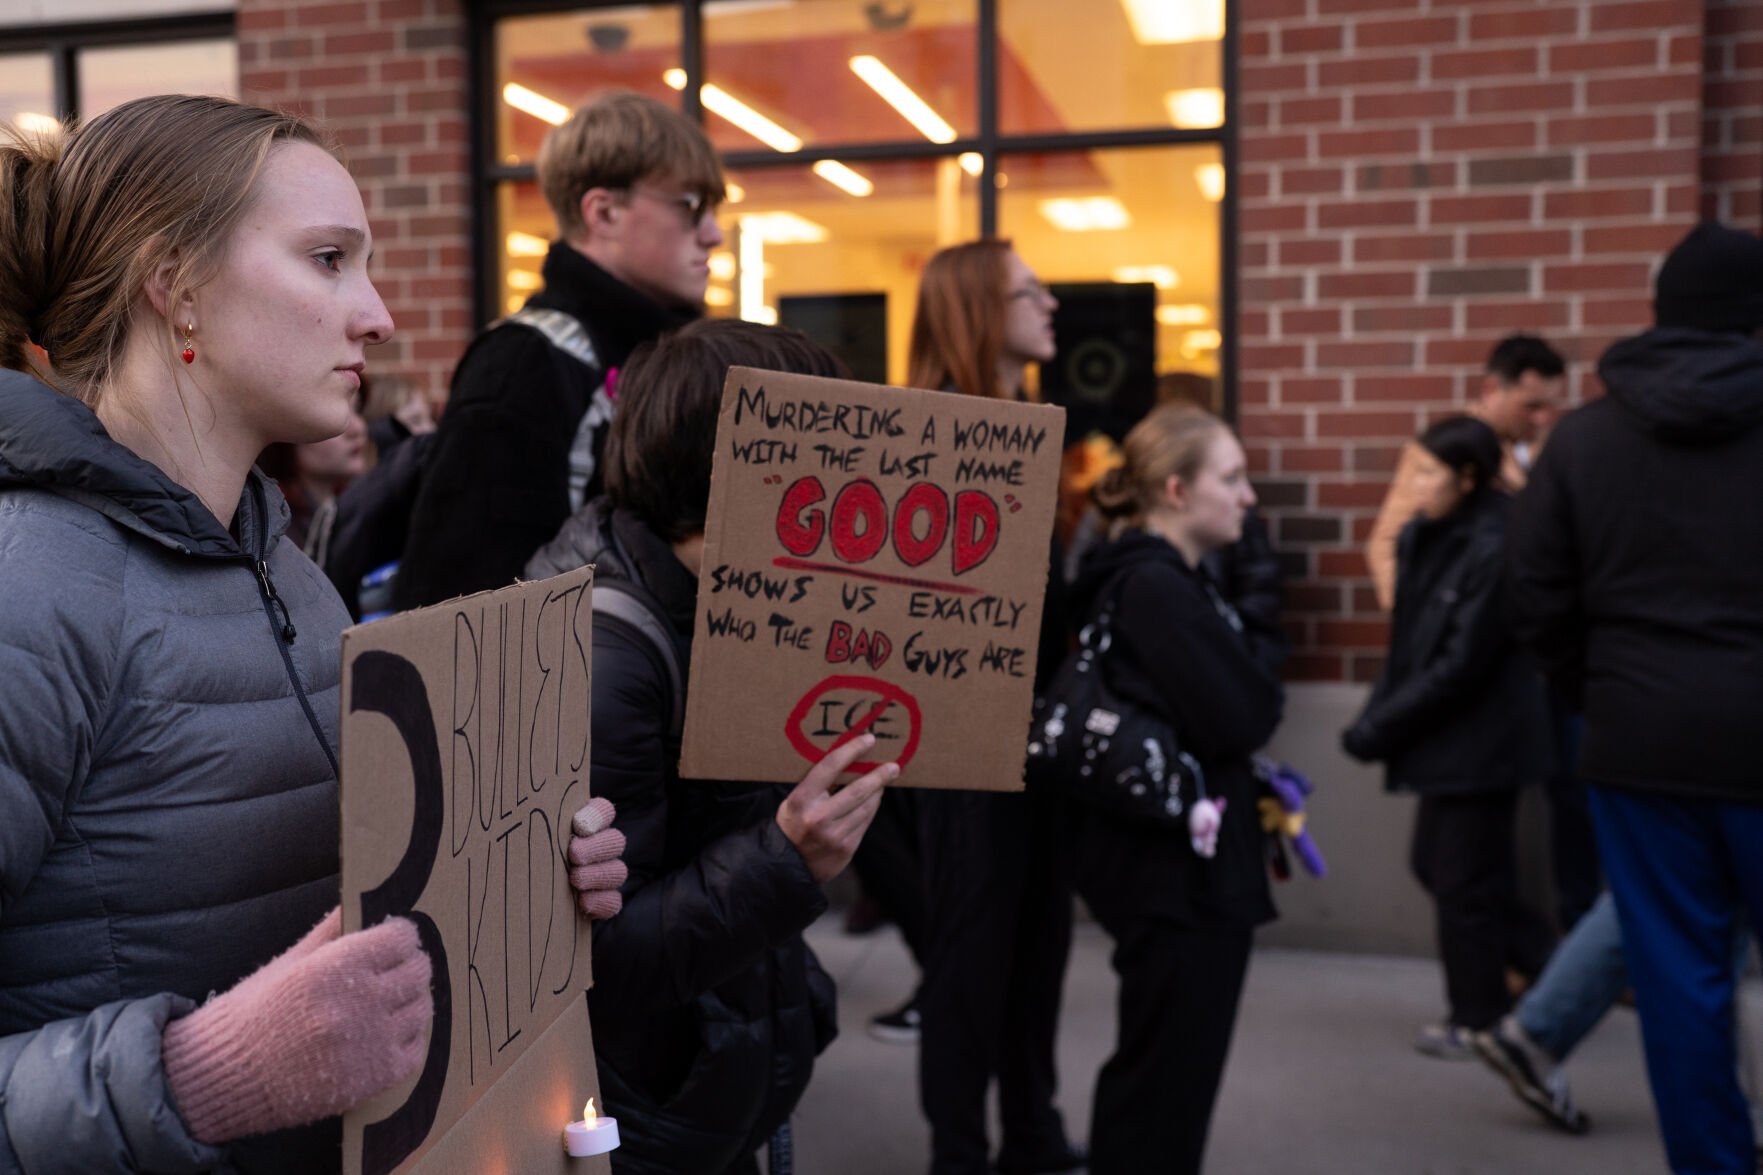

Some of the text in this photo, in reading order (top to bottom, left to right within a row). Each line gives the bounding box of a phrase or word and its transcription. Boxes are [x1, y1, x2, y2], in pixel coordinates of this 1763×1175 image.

[734, 384, 1046, 455] MURDERING A WOMAN
[732, 438, 1025, 486] WITH THE LAST NAME
[710, 564, 1027, 630] SHOWS US EXACTLY
[706, 607, 1027, 679] WHO THE BAD GUYS ARE
[453, 579, 590, 858] BULLETS
[810, 699, 900, 740] ICE
[468, 780, 579, 1086] KIDS
